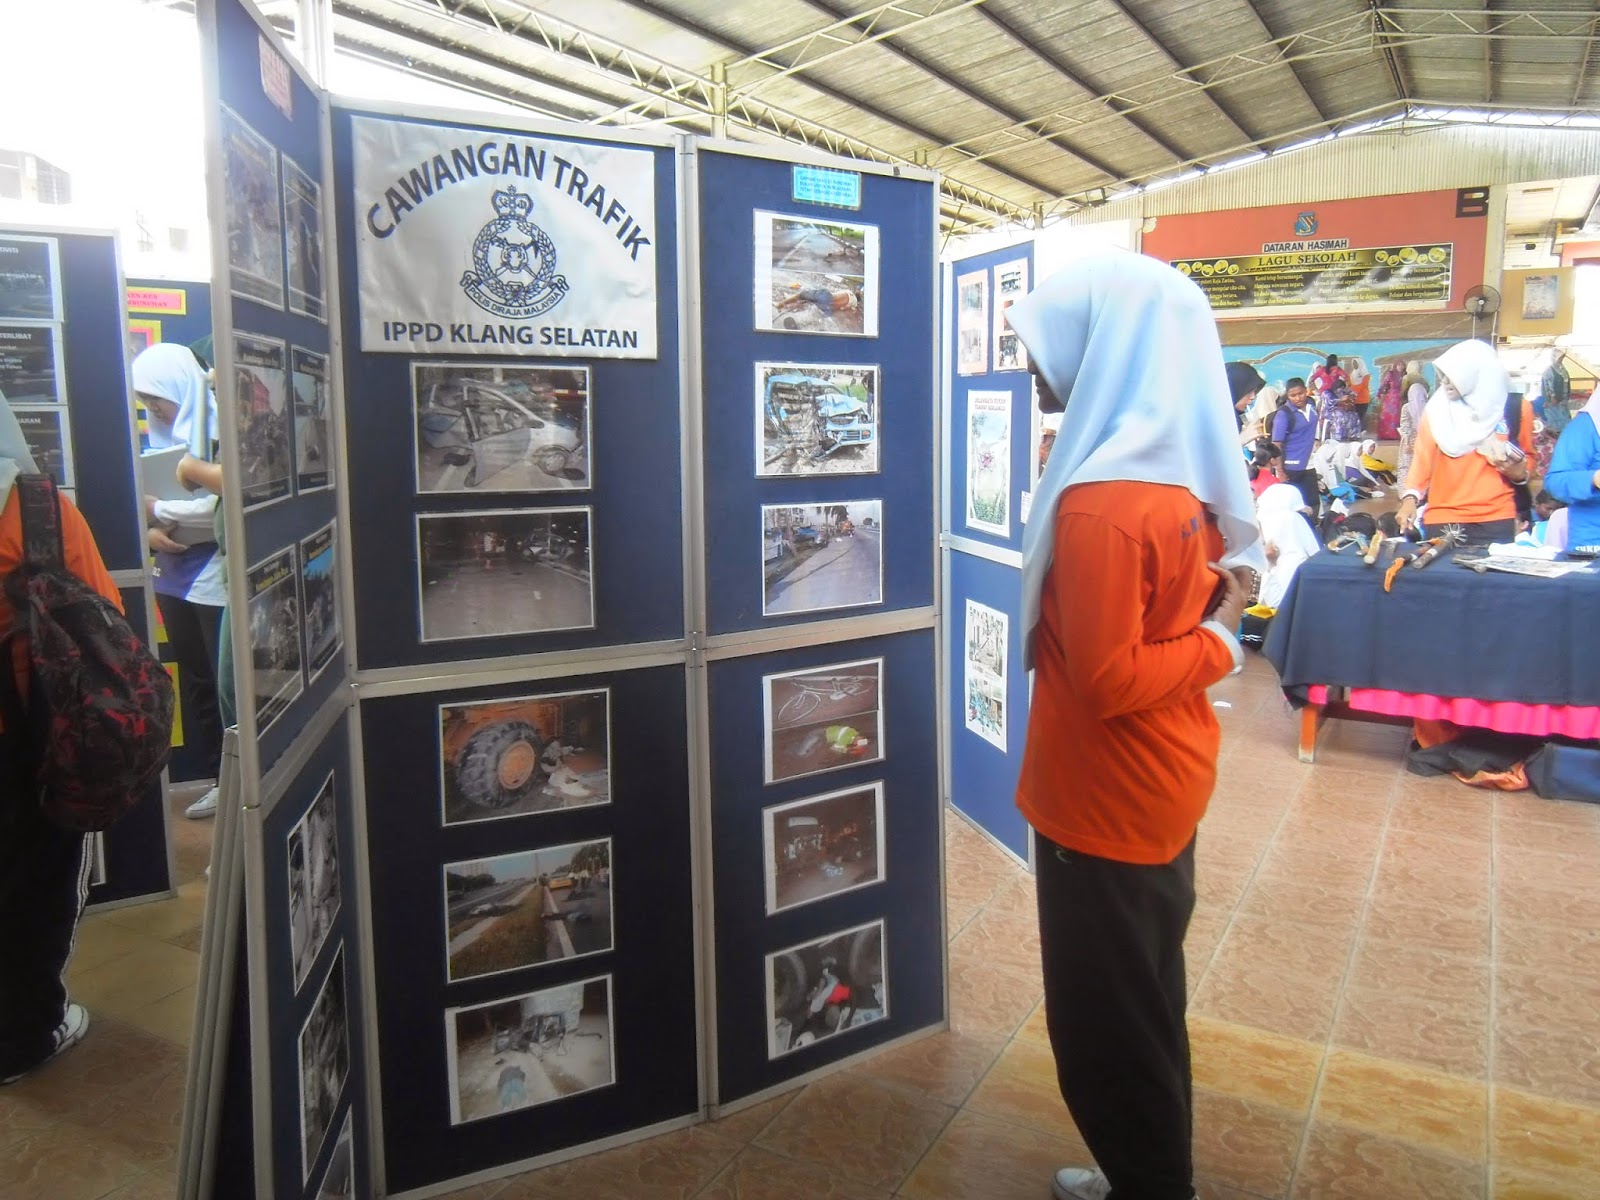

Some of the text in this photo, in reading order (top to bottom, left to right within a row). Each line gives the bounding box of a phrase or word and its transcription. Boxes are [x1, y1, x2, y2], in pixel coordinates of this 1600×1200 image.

[366, 142, 651, 262] CAWANGAN TRAFIK
[1456, 186, 1490, 218] B
[1258, 255, 1293, 266] LAGU
[1297, 252, 1357, 264] SEKOLAH
[1264, 239, 1347, 252] DATARAN HASIMAH
[468, 287, 562, 316] POLIS DIRAJA MALAYSIA
[383, 321, 638, 349] IPPD KLANG SELATAN
